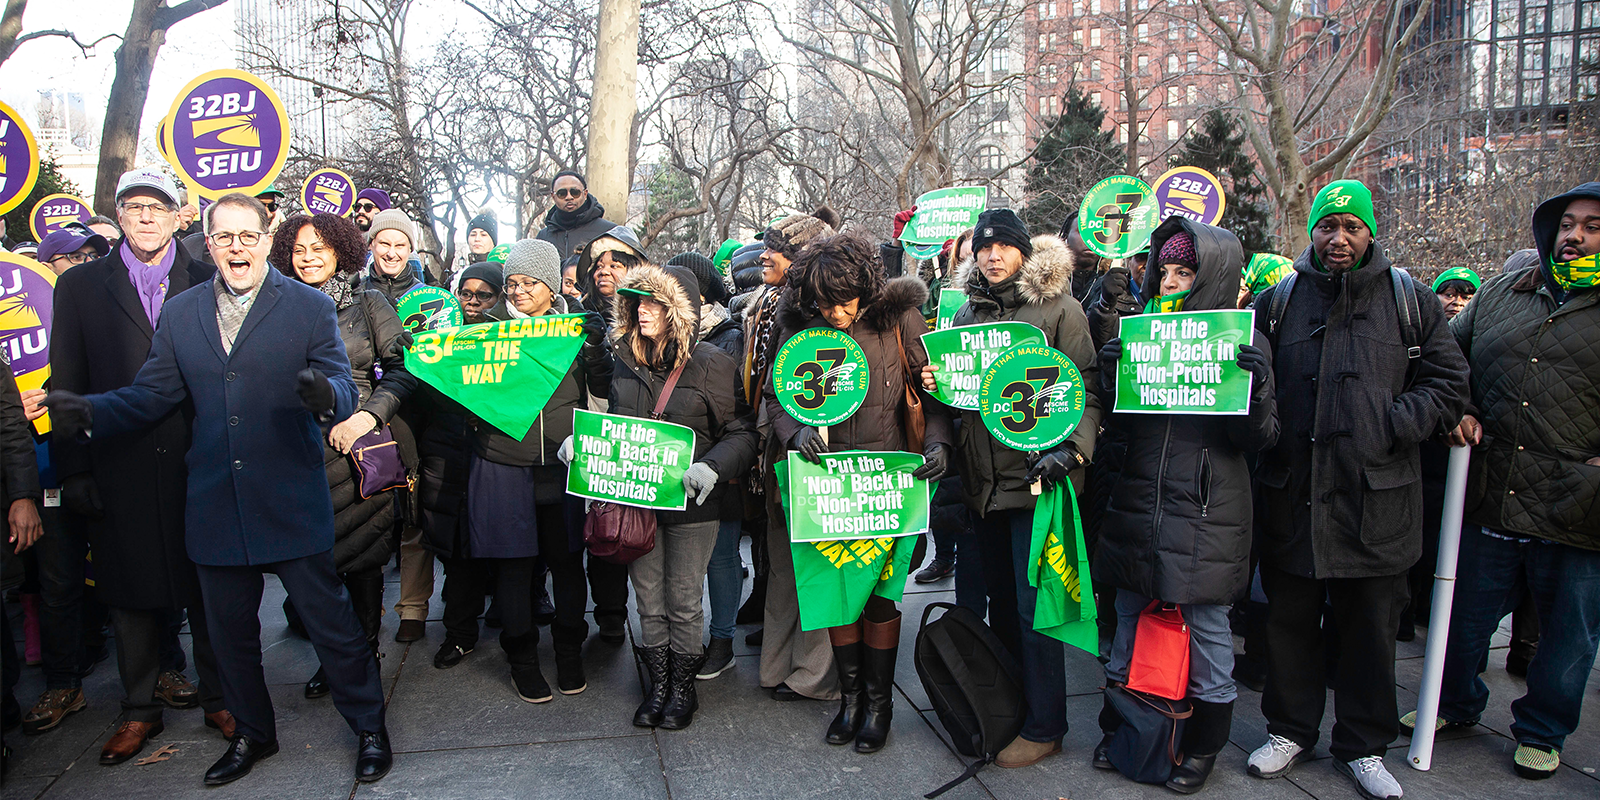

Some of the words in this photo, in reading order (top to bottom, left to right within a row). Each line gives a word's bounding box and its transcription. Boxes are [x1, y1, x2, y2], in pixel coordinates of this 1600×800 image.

[188, 90, 257, 119] 32BJ
[196, 150, 262, 178] SEIU
[316, 175, 349, 192] 32BJ
[1092, 180, 1110, 194] THAT
[1110, 177, 1136, 186] MAKES
[1136, 182, 1151, 196] THIS
[1168, 176, 1212, 196] 32BJ
[43, 203, 80, 217] 32BJ
[309, 200, 341, 215] SEIU
[1081, 194, 1095, 215] UNION
[1148, 195, 1158, 212] CITY
[1335, 195, 1352, 207] 37
[932, 208, 971, 223] Private
[1088, 220, 1102, 229] DC
[1093, 192, 1144, 245] 37
[1149, 212, 1158, 229] RUN
[396, 294, 412, 308] THAT
[413, 288, 437, 297] MAKES
[437, 289, 451, 300] THIS
[449, 297, 459, 311] CITY
[498, 317, 583, 339] LEADING
[808, 329, 839, 339] MAKES
[1150, 319, 1178, 341] Put
[1181, 318, 1208, 339] the
[410, 343, 425, 354] DC
[417, 327, 460, 364] 37
[787, 333, 807, 349] THAT
[839, 335, 856, 351] THIS
[960, 330, 986, 351] Put
[987, 328, 1012, 349] the
[482, 340, 522, 361] THE
[853, 350, 866, 369] CITY
[981, 349, 1005, 370] Ba
[994, 351, 1015, 368] THAT
[1017, 347, 1050, 357] MAKES
[1051, 352, 1070, 369] THIS
[1169, 340, 1214, 362] Back
[1218, 339, 1235, 361] in
[775, 349, 790, 375] UNION
[461, 363, 507, 386] WAY
[793, 347, 847, 410] 37
[858, 371, 867, 390] RUN
[981, 368, 997, 396] UNION
[1067, 368, 1081, 388] CITY
[1136, 362, 1222, 384] Non-Profit
[775, 377, 785, 394] THE
[786, 381, 802, 391] DC
[1000, 365, 1061, 434] 37
[1074, 390, 1083, 411] RUN
[1140, 385, 1216, 408] Hospitals
[981, 398, 991, 417] THE
[992, 402, 1011, 413] DC
[601, 419, 627, 440] Put
[631, 423, 657, 444] the
[619, 440, 662, 463] Back
[662, 446, 679, 467] in
[586, 455, 665, 484] Non-Profit
[825, 456, 855, 474] Put
[857, 456, 886, 472] the
[588, 474, 657, 502] Hospitals
[851, 472, 894, 492] Back
[897, 471, 914, 489] in
[816, 490, 904, 514] Non-Profit
[821, 511, 900, 535] Hospitals
